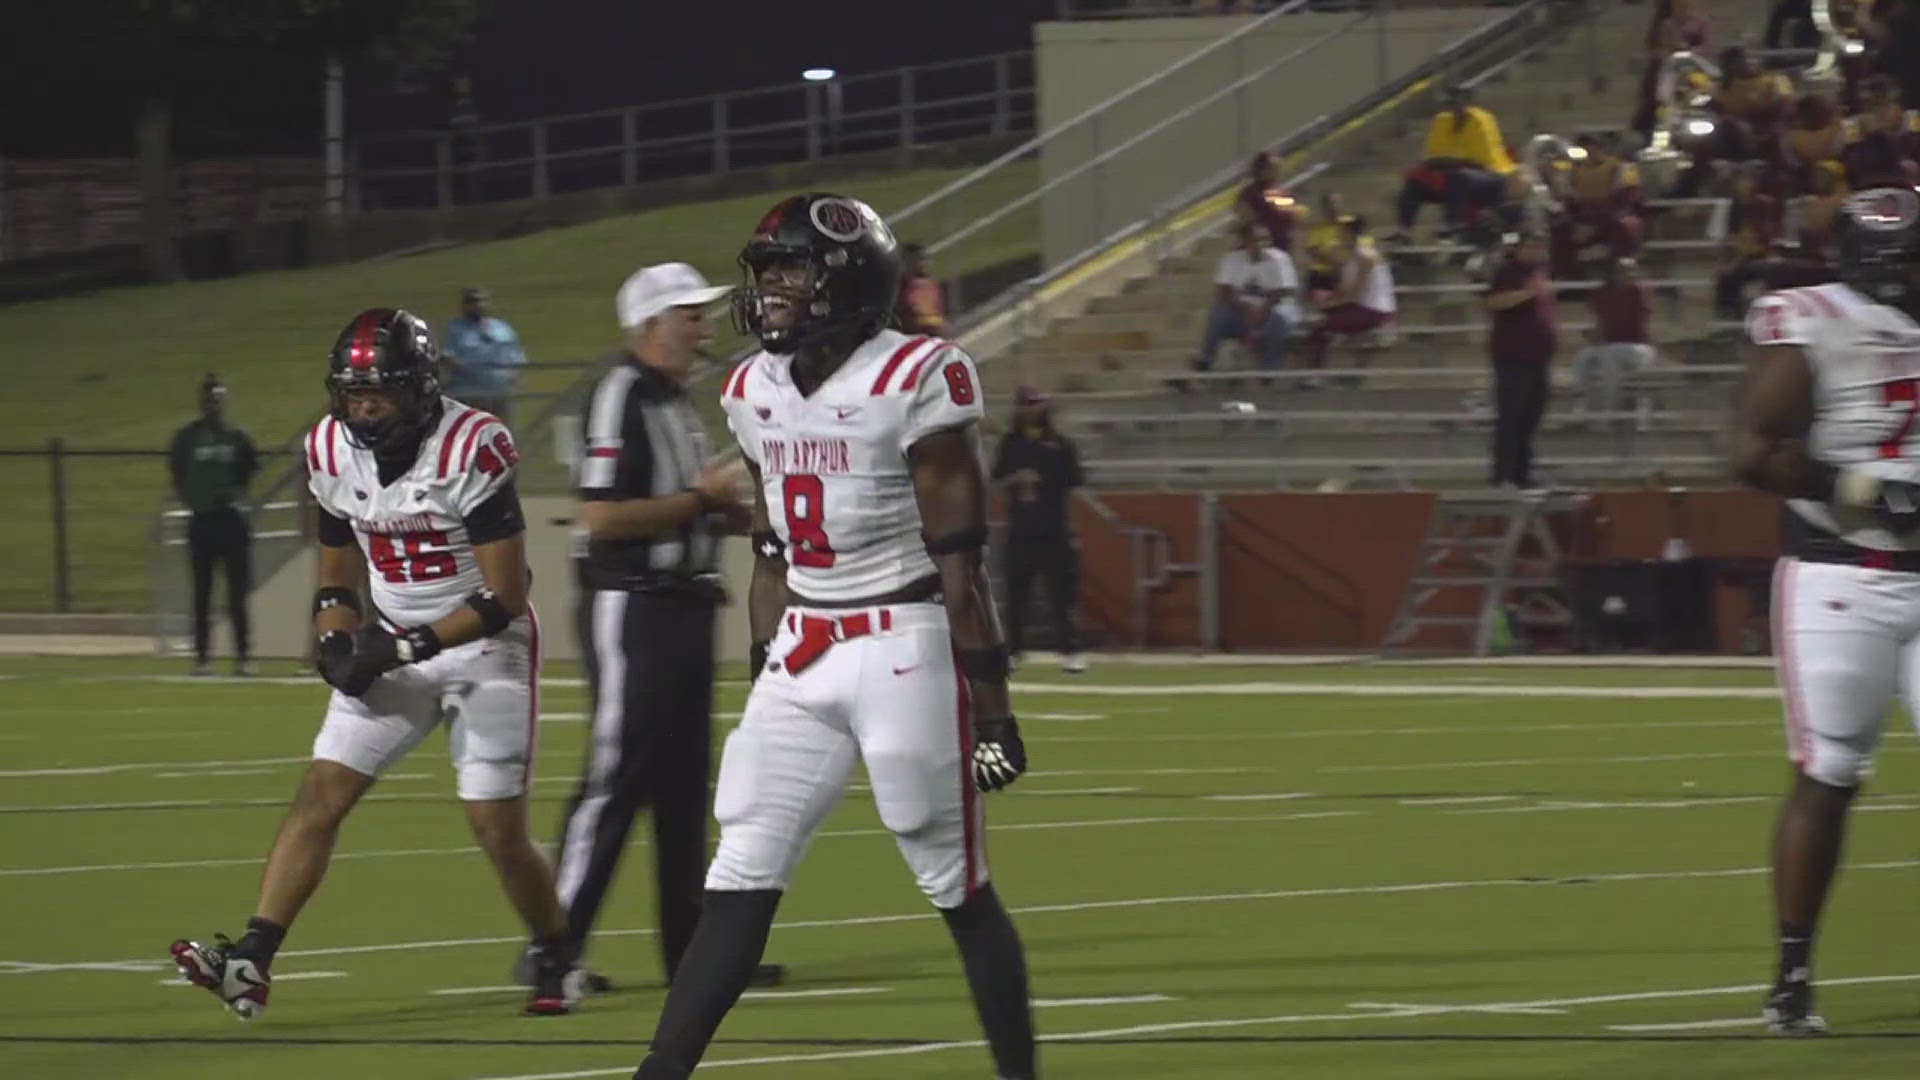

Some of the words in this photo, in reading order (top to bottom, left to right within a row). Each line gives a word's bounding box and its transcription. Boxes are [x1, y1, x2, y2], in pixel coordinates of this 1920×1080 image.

[943, 361, 975, 406] 8
[793, 437, 850, 474] ARTHUR
[782, 474, 836, 569] 8
[368, 531, 459, 583] 46
